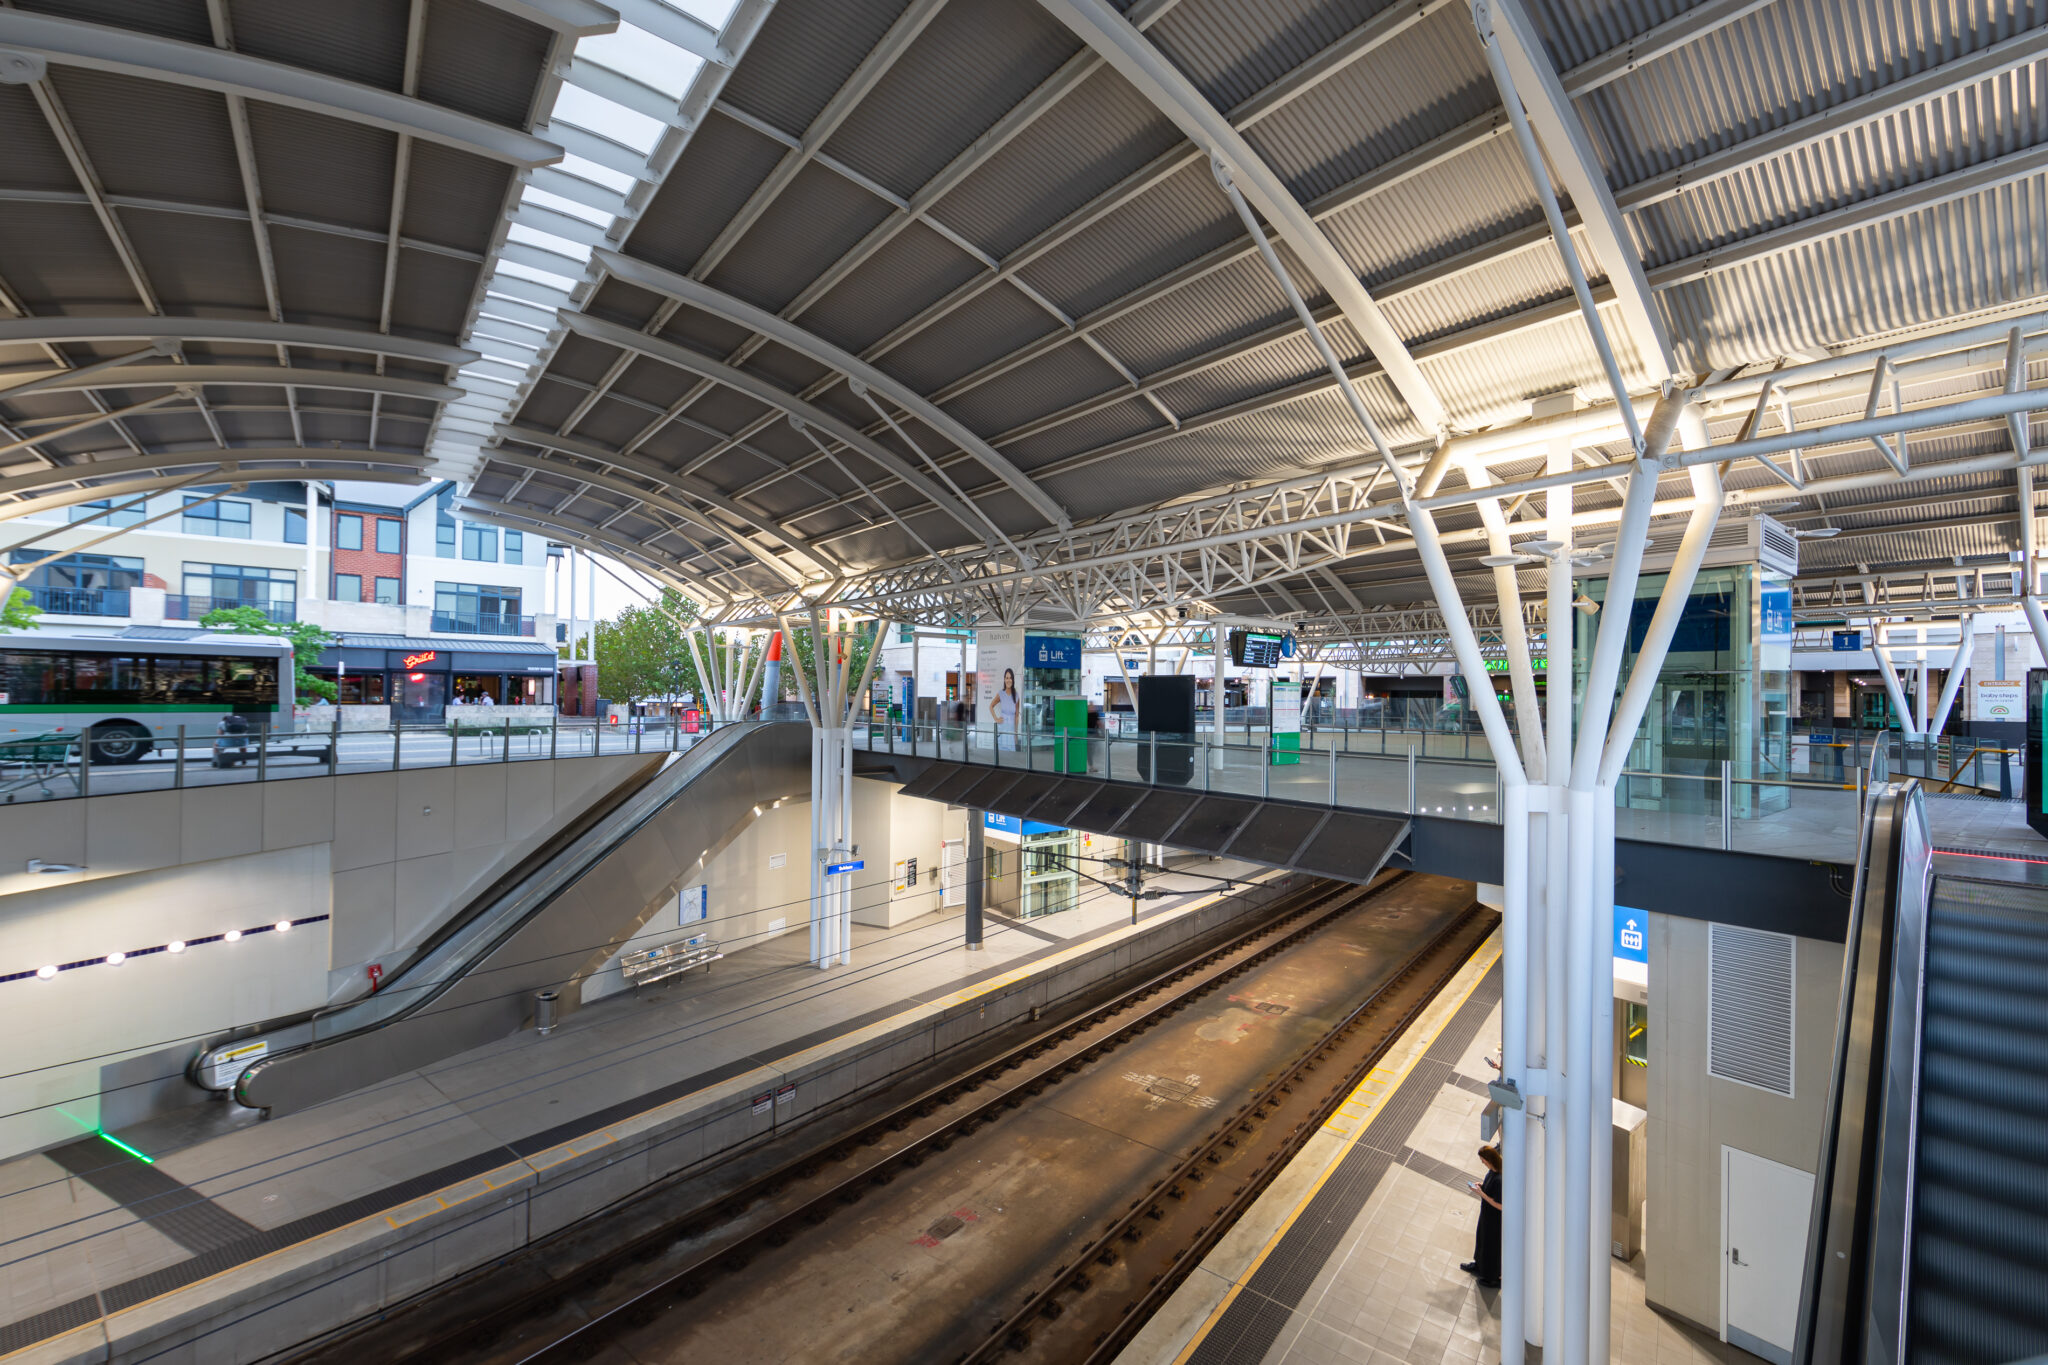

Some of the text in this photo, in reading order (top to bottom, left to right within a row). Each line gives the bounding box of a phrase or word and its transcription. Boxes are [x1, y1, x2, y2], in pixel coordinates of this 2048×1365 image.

[1843, 636, 1849, 646] 1
[1051, 650, 1064, 660] Lift
[996, 814, 1006, 823] Lift
